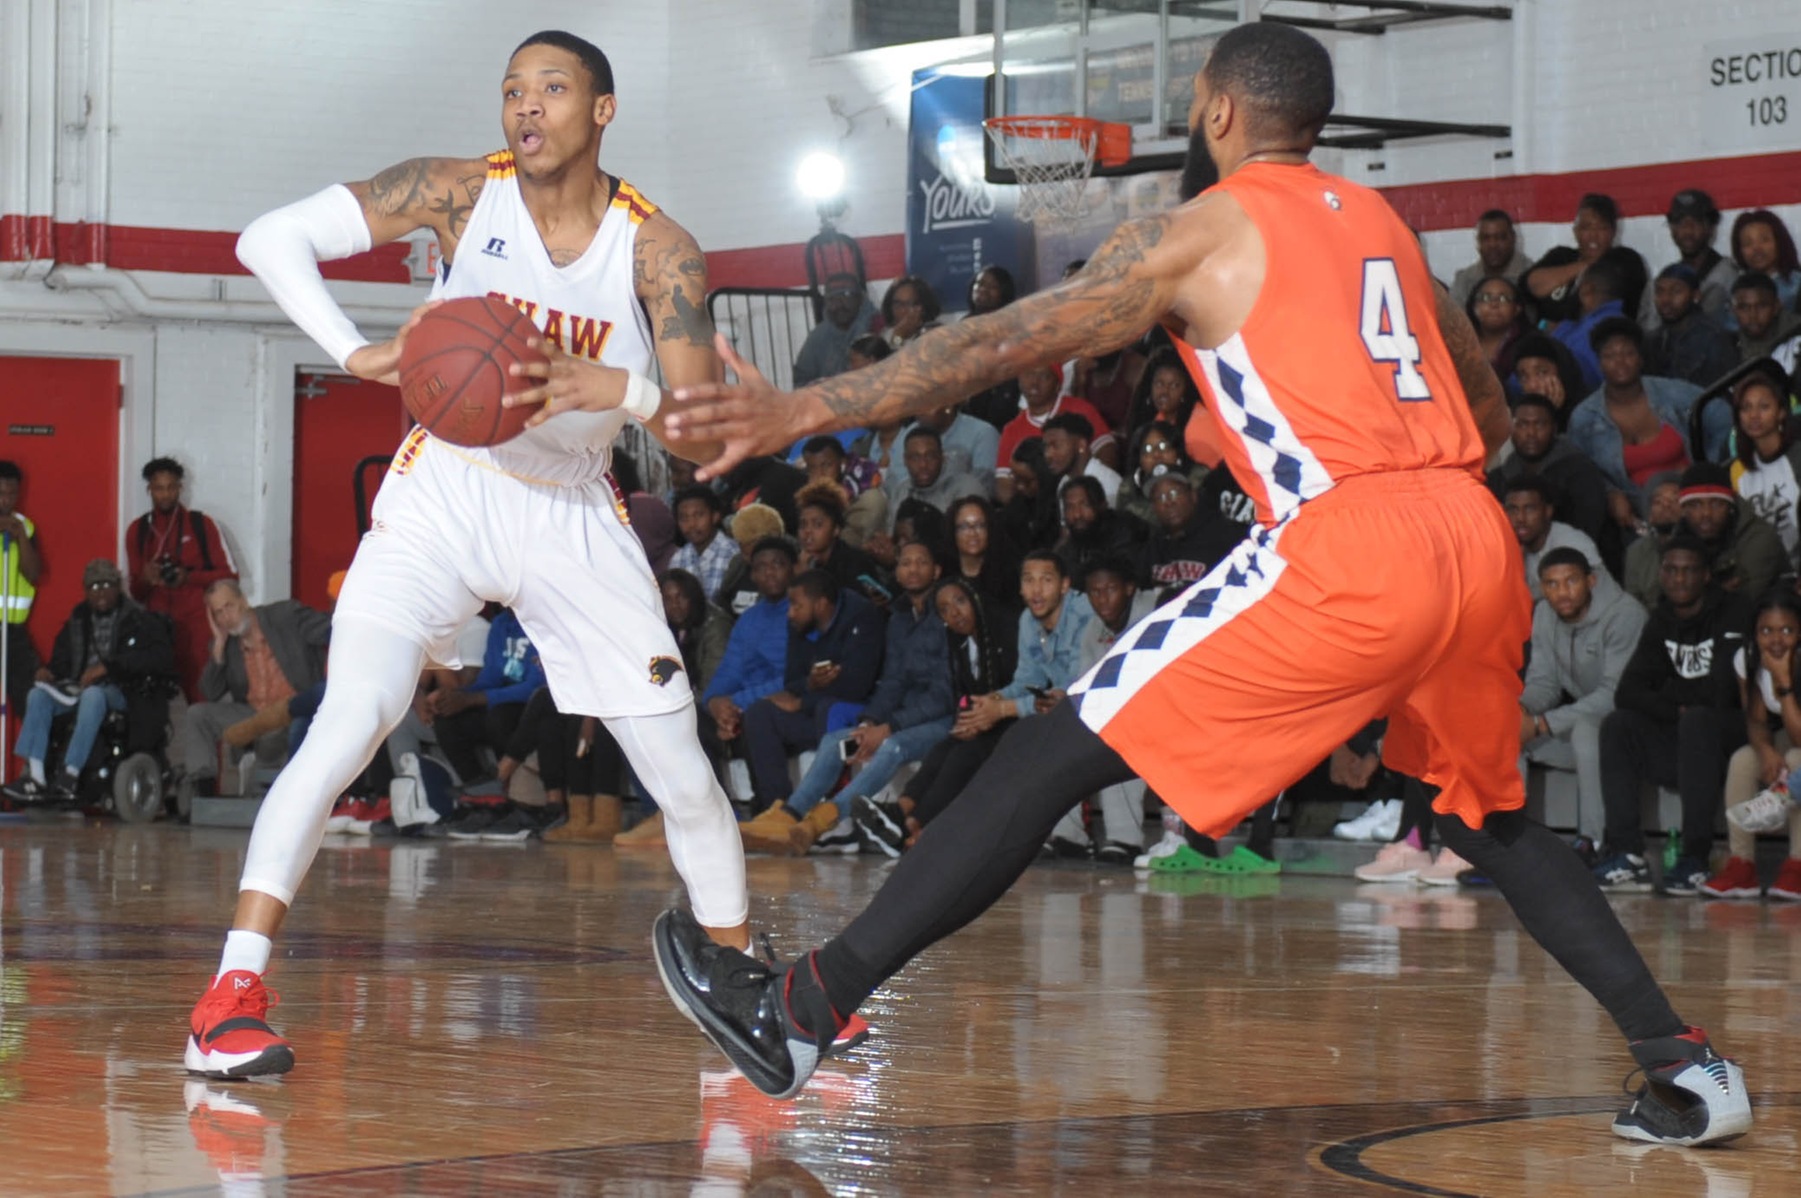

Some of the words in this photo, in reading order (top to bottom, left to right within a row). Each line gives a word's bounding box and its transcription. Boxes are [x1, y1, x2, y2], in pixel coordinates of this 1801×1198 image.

[1710, 47, 1801, 87] SECTIO
[1745, 94, 1787, 127] 103
[486, 290, 615, 362] AW
[1358, 257, 1433, 402] 4
